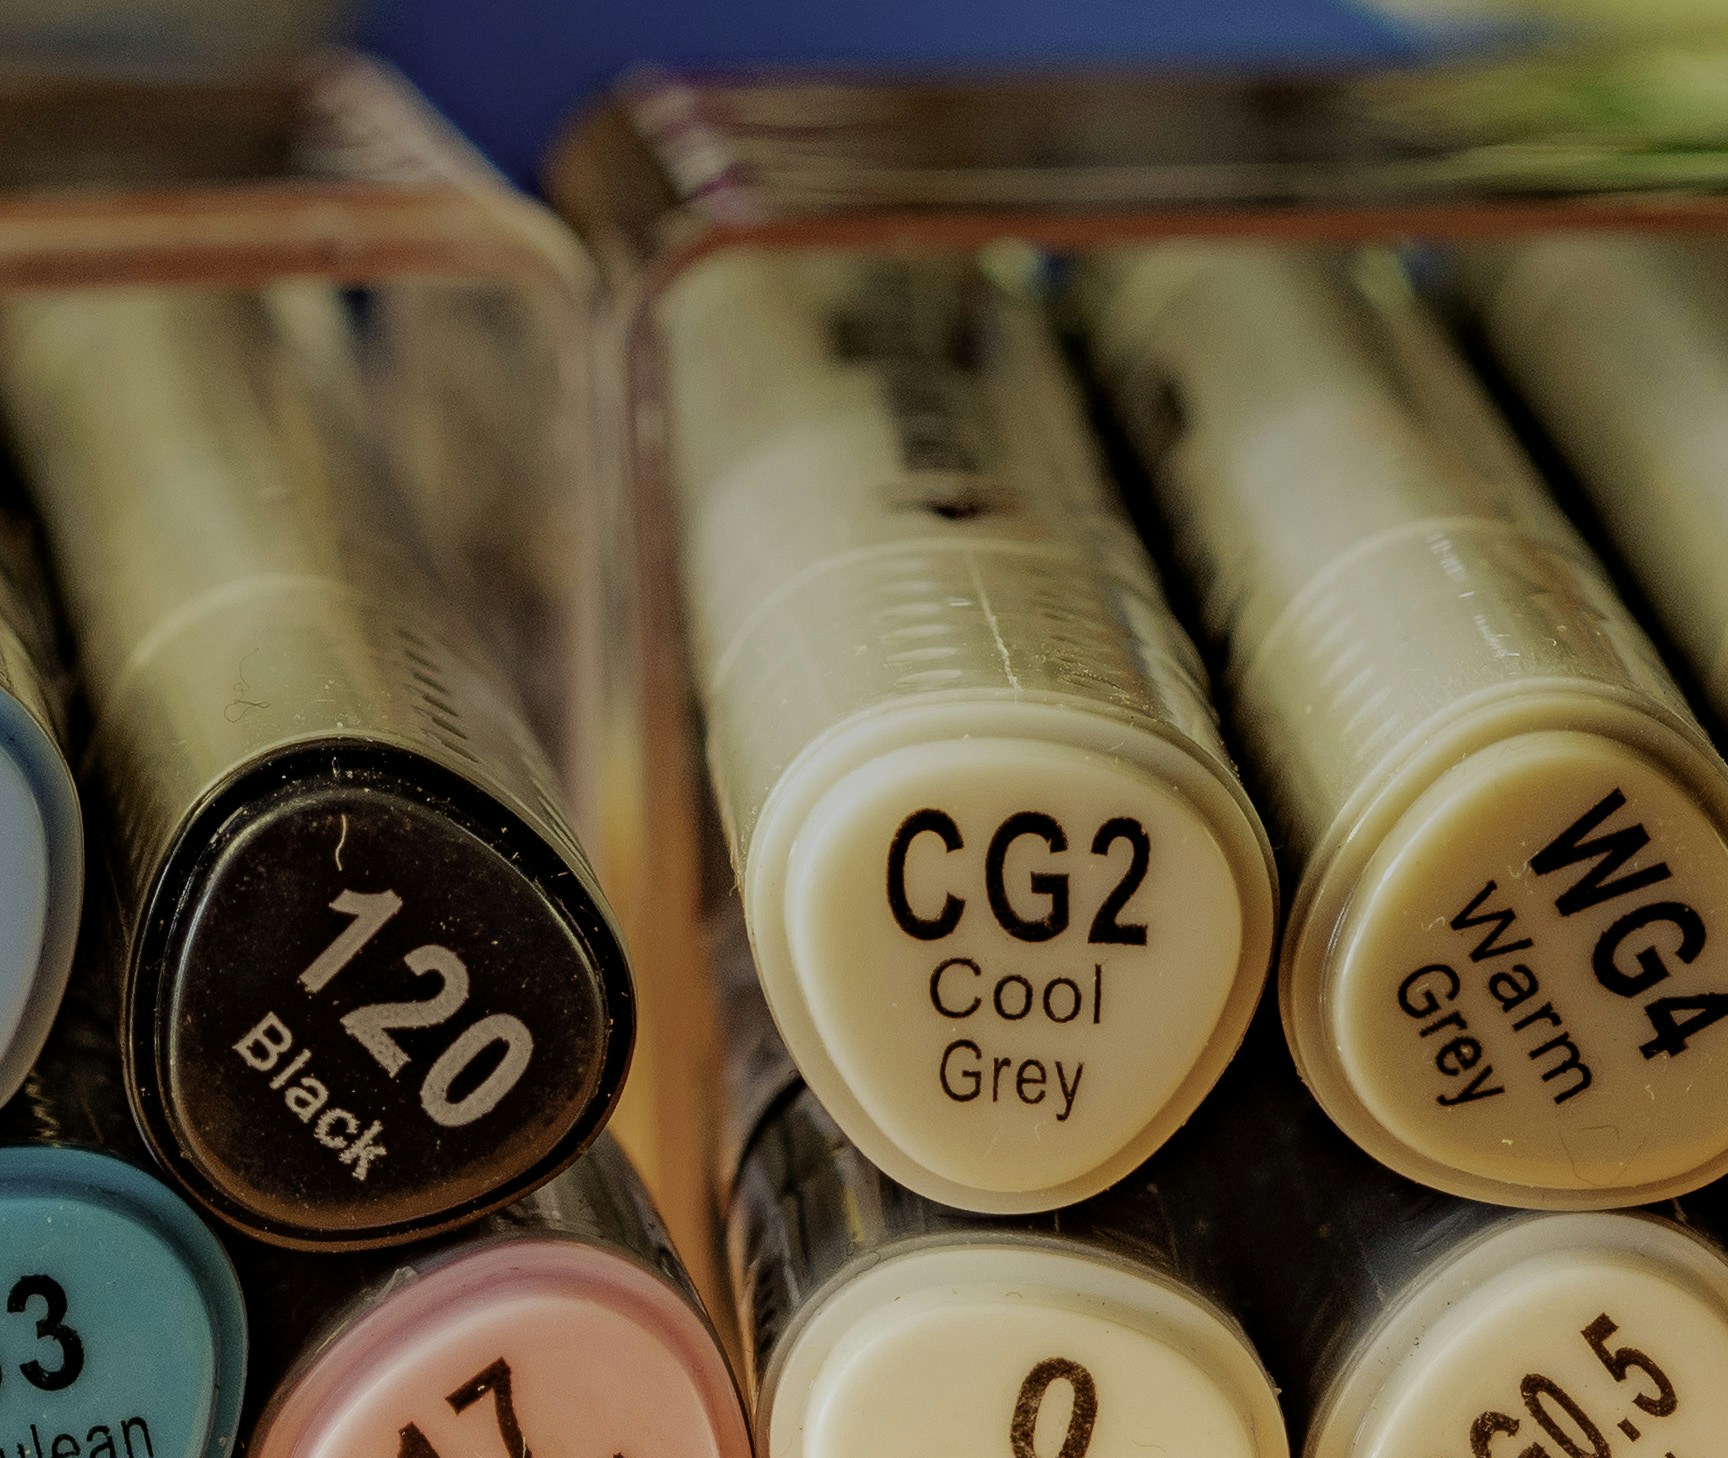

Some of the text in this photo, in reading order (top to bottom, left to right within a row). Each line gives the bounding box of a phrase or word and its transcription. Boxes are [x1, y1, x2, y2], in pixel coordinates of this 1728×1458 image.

[886, 809, 1151, 946] CG2
[298, 889, 533, 1126] 120
[930, 958, 1103, 1023] Cool
[1397, 964, 1505, 1107] Grey
[1450, 881, 1593, 1104] Warm
[232, 1011, 388, 1180] Black
[940, 1039, 1083, 1120] Grey
